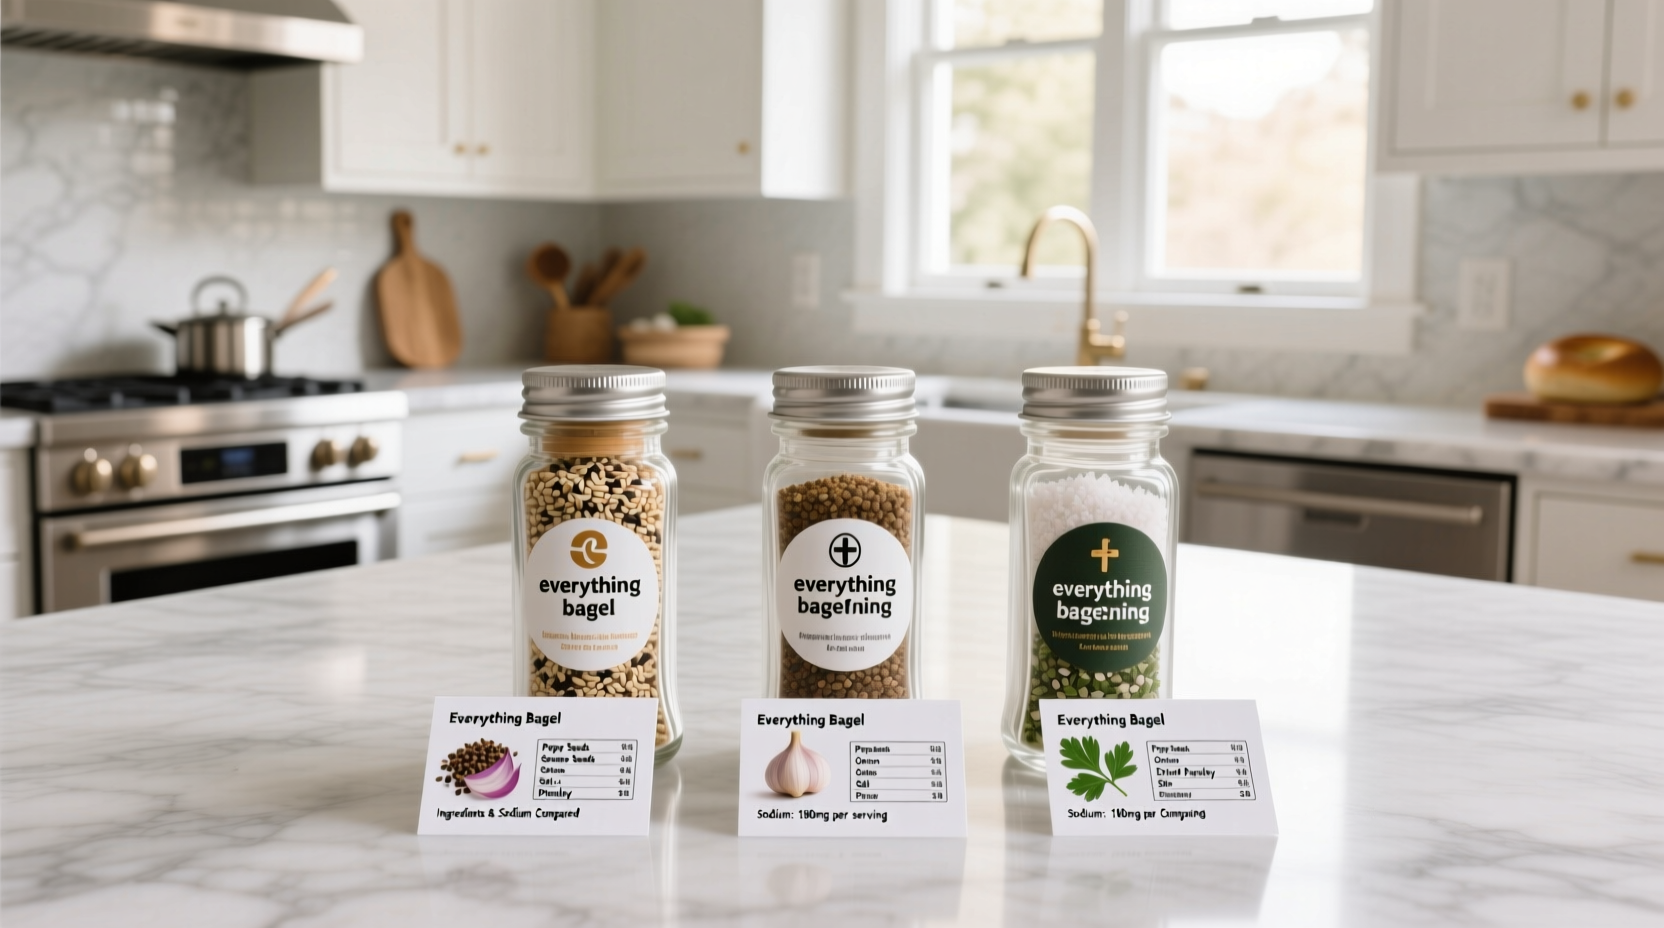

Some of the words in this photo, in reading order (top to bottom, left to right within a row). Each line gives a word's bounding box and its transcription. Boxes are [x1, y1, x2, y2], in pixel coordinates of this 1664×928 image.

[539, 575, 641, 599] everything
[794, 575, 896, 597] everything
[1052, 579, 1152, 602] everything
[562, 598, 615, 621] bagel
[449, 711, 522, 727] Everything
[526, 711, 562, 726] Bagel
[757, 713, 826, 728] Everything
[829, 713, 865, 728] Bagel
[1057, 713, 1127, 729] Everything
[1130, 713, 1165, 728] Bagel
[832, 811, 849, 822] per
[852, 810, 888, 823] serving
